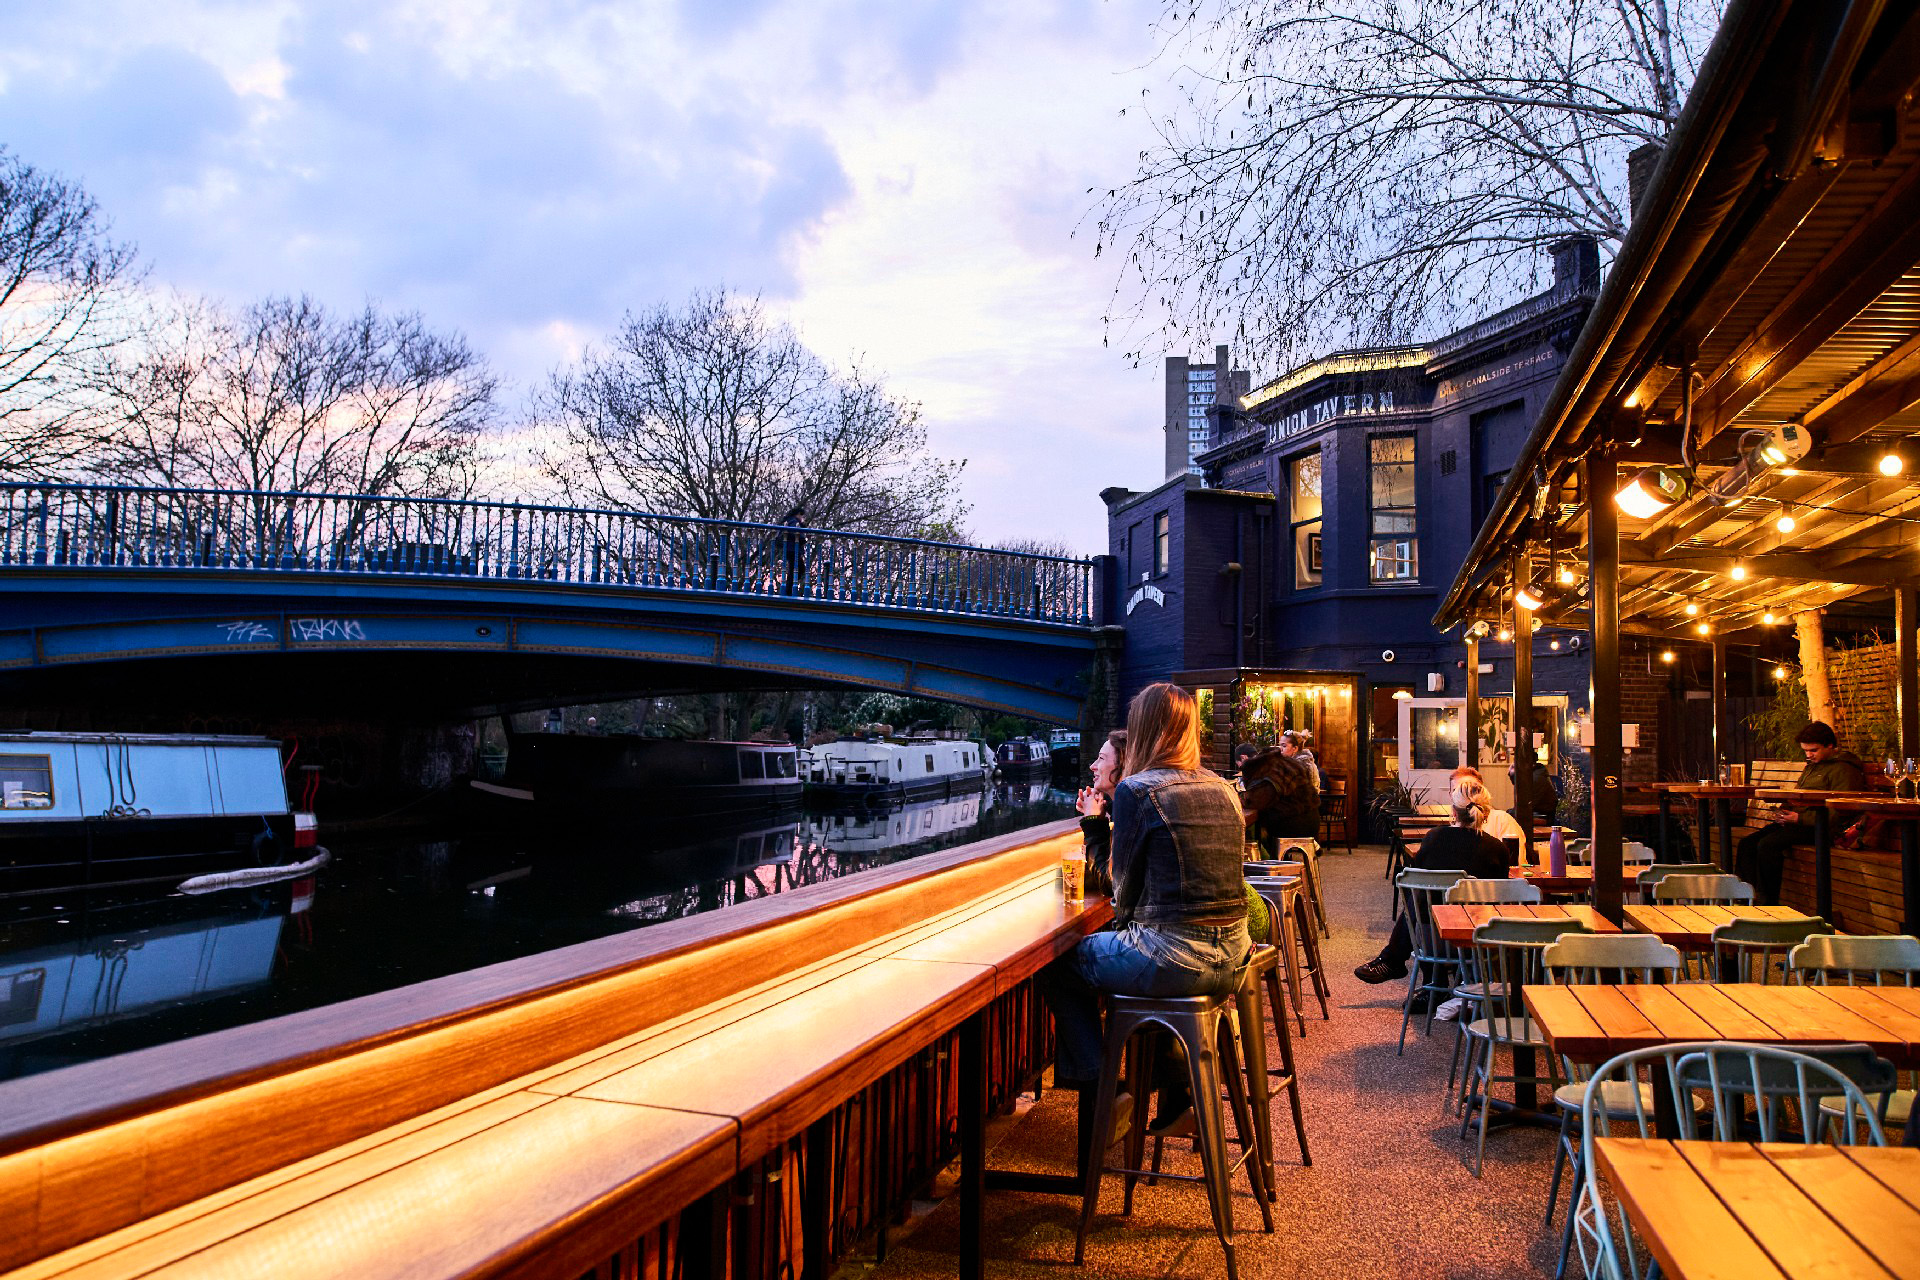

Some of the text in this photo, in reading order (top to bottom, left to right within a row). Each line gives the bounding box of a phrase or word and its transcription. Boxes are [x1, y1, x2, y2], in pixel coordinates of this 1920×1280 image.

[1466, 365, 1511, 388] CANALSIDE
[1513, 350, 1553, 371] TERRACE
[1269, 391, 1394, 444] UNION TAVERN
